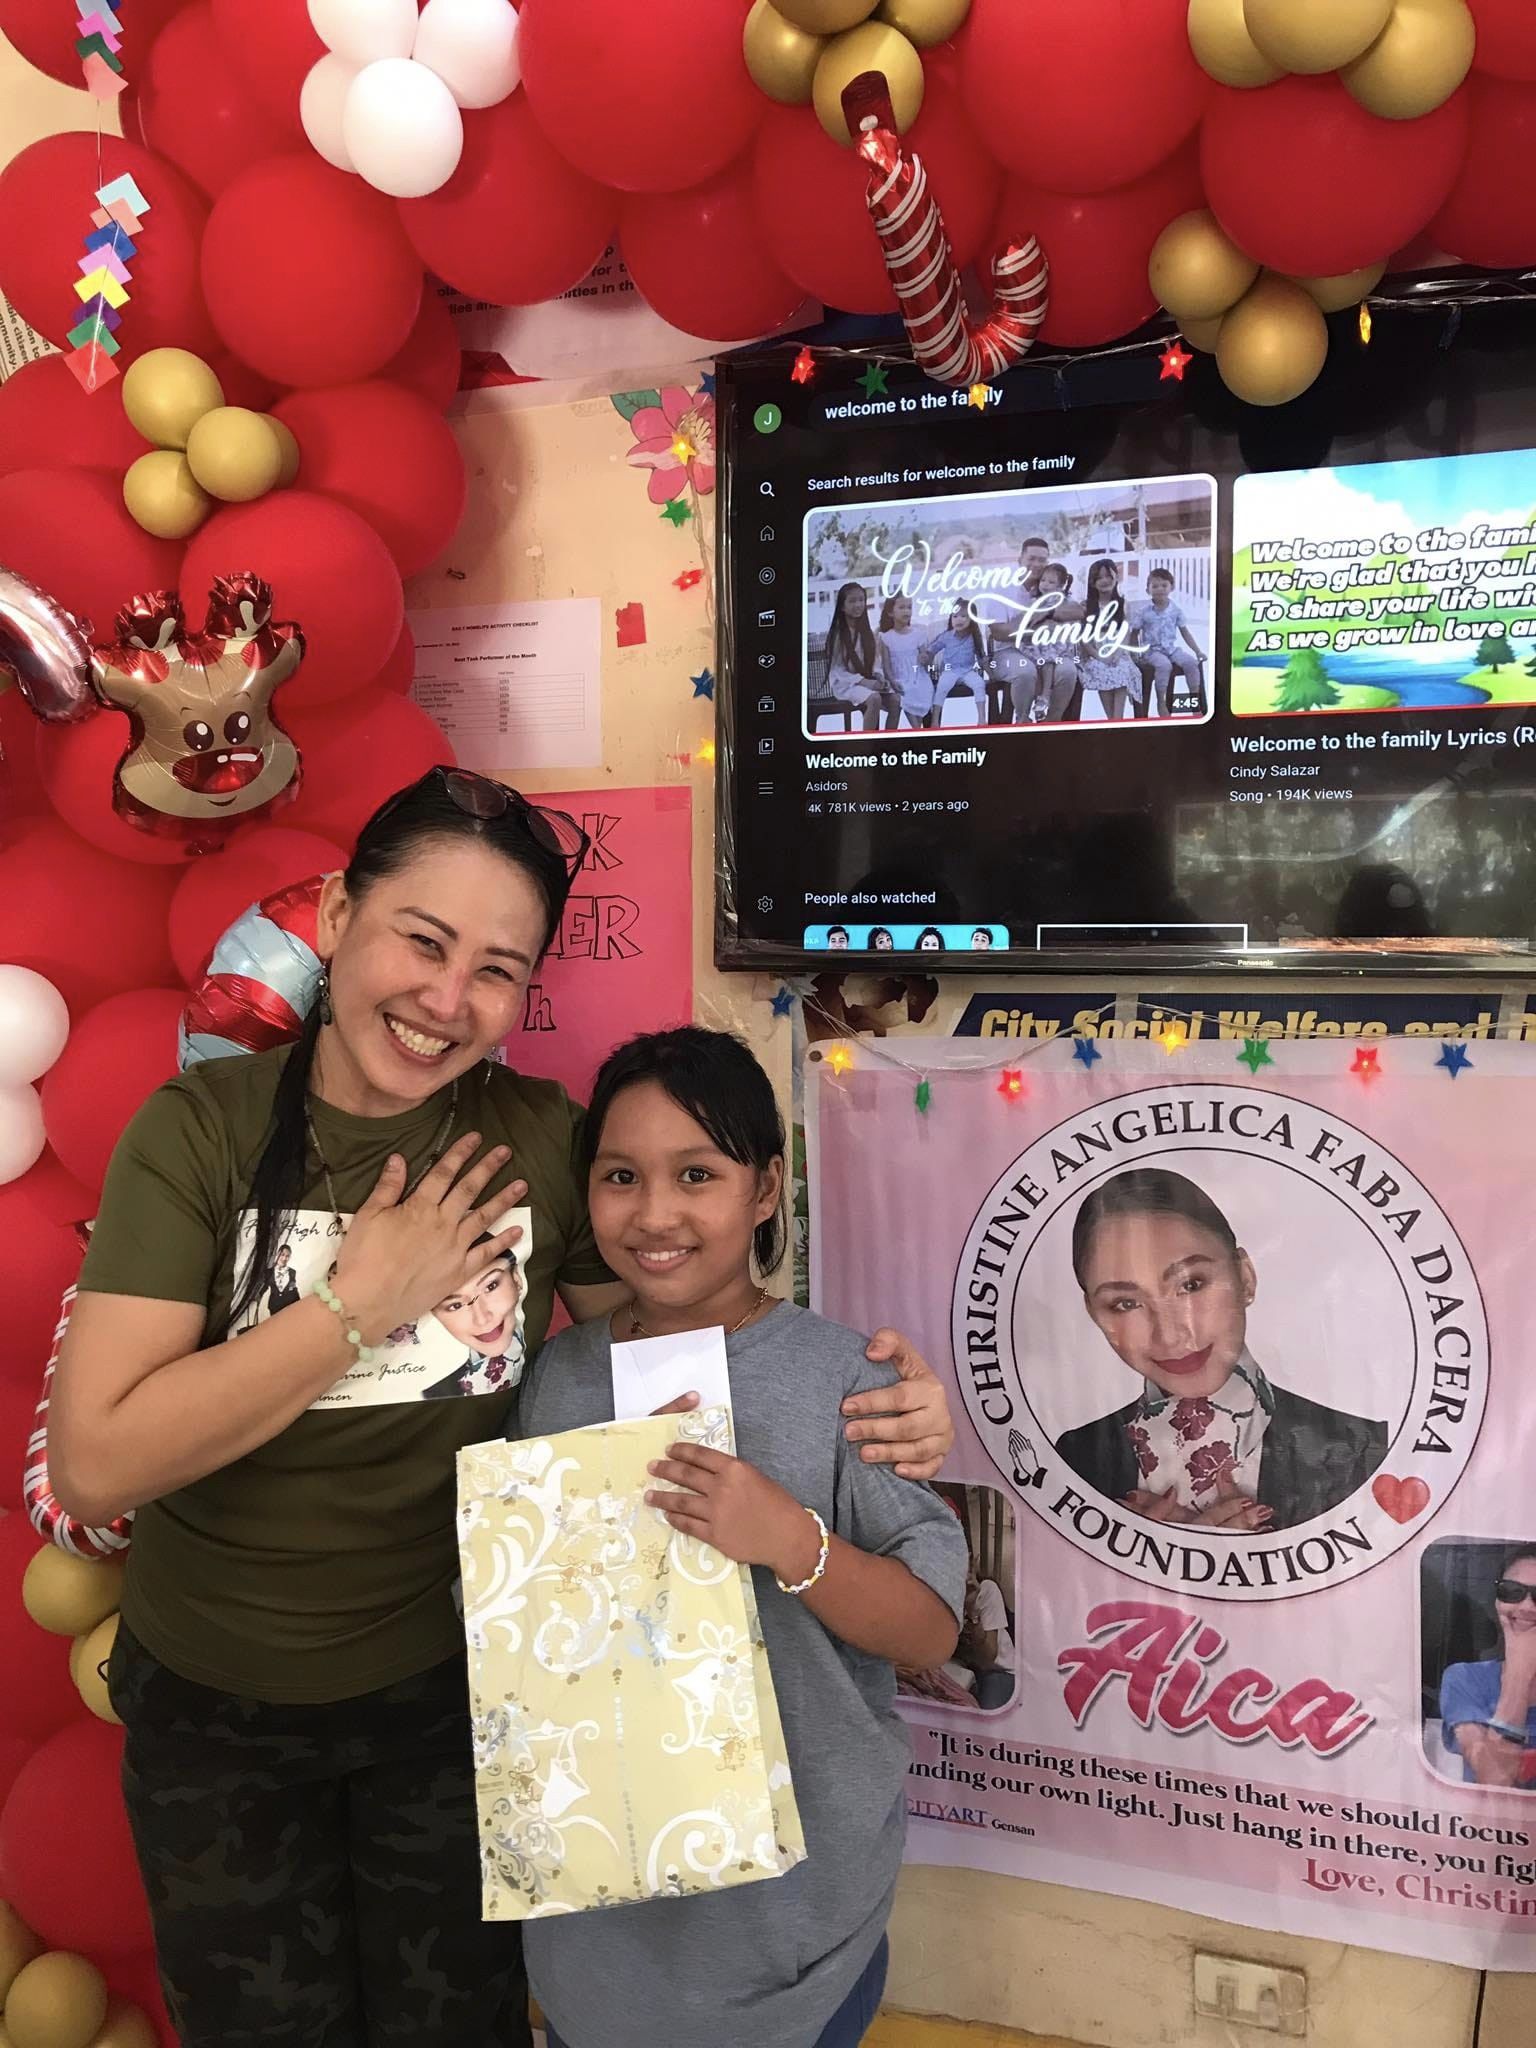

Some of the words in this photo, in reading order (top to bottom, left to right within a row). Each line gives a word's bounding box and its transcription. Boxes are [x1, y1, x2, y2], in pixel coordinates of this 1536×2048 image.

[602, 282, 615, 294] in
[619, 280, 635, 292] th
[763, 411, 773, 426] J
[825, 398, 896, 420] welcome
[900, 397, 916, 412] to
[921, 393, 947, 410] the
[951, 386, 1003, 407] faily
[807, 473, 852, 491] Search
[855, 471, 899, 487] results
[903, 468, 922, 483] for
[925, 466, 986, 480] welcome
[989, 462, 1003, 474] to
[1006, 459, 1028, 473] the
[1032, 455, 1076, 471] family
[1251, 537, 1375, 563] Welcome
[1380, 533, 1412, 555] to
[1417, 528, 1466, 551] the
[872, 536, 1032, 599] Welcome
[1251, 569, 1327, 592] We're
[1330, 560, 1396, 592] glad
[1399, 558, 1462, 583] that
[1462, 558, 1522, 584] you
[1251, 600, 1284, 622] To
[1288, 597, 1365, 620] share
[1368, 593, 1436, 621] your
[1439, 586, 1489, 611] life
[967, 592, 1150, 658] Family
[1246, 630, 1283, 652] As
[1288, 629, 1330, 649] we
[1334, 626, 1407, 652] grow
[1410, 621, 1440, 643] in
[1443, 617, 1506, 641] love
[911, 663, 952, 673] THE
[973, 655, 1081, 670] ASIDORS
[1172, 696, 1199, 709] 4:45
[1230, 736, 1317, 753] Welcome
[1321, 735, 1341, 750] to
[1346, 733, 1376, 749] the
[1381, 730, 1442, 751] family
[1447, 728, 1507, 749] Lyrics
[1513, 726, 1536, 748] (R
[806, 753, 878, 769] Welcome
[882, 752, 898, 767] to
[902, 750, 928, 766] the
[932, 747, 987, 767] Family
[1230, 765, 1267, 779] Cindy
[1270, 764, 1320, 778] Salazar
[806, 781, 848, 792] Asidors
[1230, 790, 1264, 805] Song
[1277, 788, 1311, 801] 194K
[1315, 788, 1353, 800] views
[808, 803, 822, 813] 4K
[828, 802, 856, 813] 781K
[859, 801, 891, 812] views
[902, 801, 909, 812] 2
[912, 800, 944, 813] years
[947, 801, 969, 814] ago
[804, 892, 848, 906] People
[851, 891, 878, 905] also
[881, 891, 936, 904] watched
[967, 1175, 1049, 1427] CHRISTINE
[1048, 1100, 1295, 1184] ANGELICA
[1305, 1128, 1423, 1244] FABA
[1410, 1244, 1472, 1456] DACERA
[378, 1362, 427, 1382] Justice
[1048, 1515, 1374, 1589] FOUNDATION
[1057, 1600, 1374, 1758] Aica
[965, 1737, 984, 1758] is
[989, 1743, 1075, 1779] during
[1080, 1757, 1147, 1786] these
[1154, 1770, 1228, 1800] times
[1235, 1784, 1290, 1812] that
[1296, 1799, 1334, 1818] we
[1341, 1802, 1441, 1836] should
[1448, 1815, 1530, 1847] focus
[991, 1818, 1036, 1837] Gensan
[991, 1776, 1035, 1795] our
[1039, 1784, 1091, 1806] own
[1098, 1788, 1165, 1818] light.
[1168, 1802, 1226, 1831] Just
[1233, 1811, 1304, 1850] hang
[1309, 1827, 1338, 1851] in
[1344, 1834, 1427, 1866] there,
[1434, 1852, 1486, 1873] you
[1494, 1854, 1536, 1886] fig
[1302, 1857, 1385, 1897] Love,
